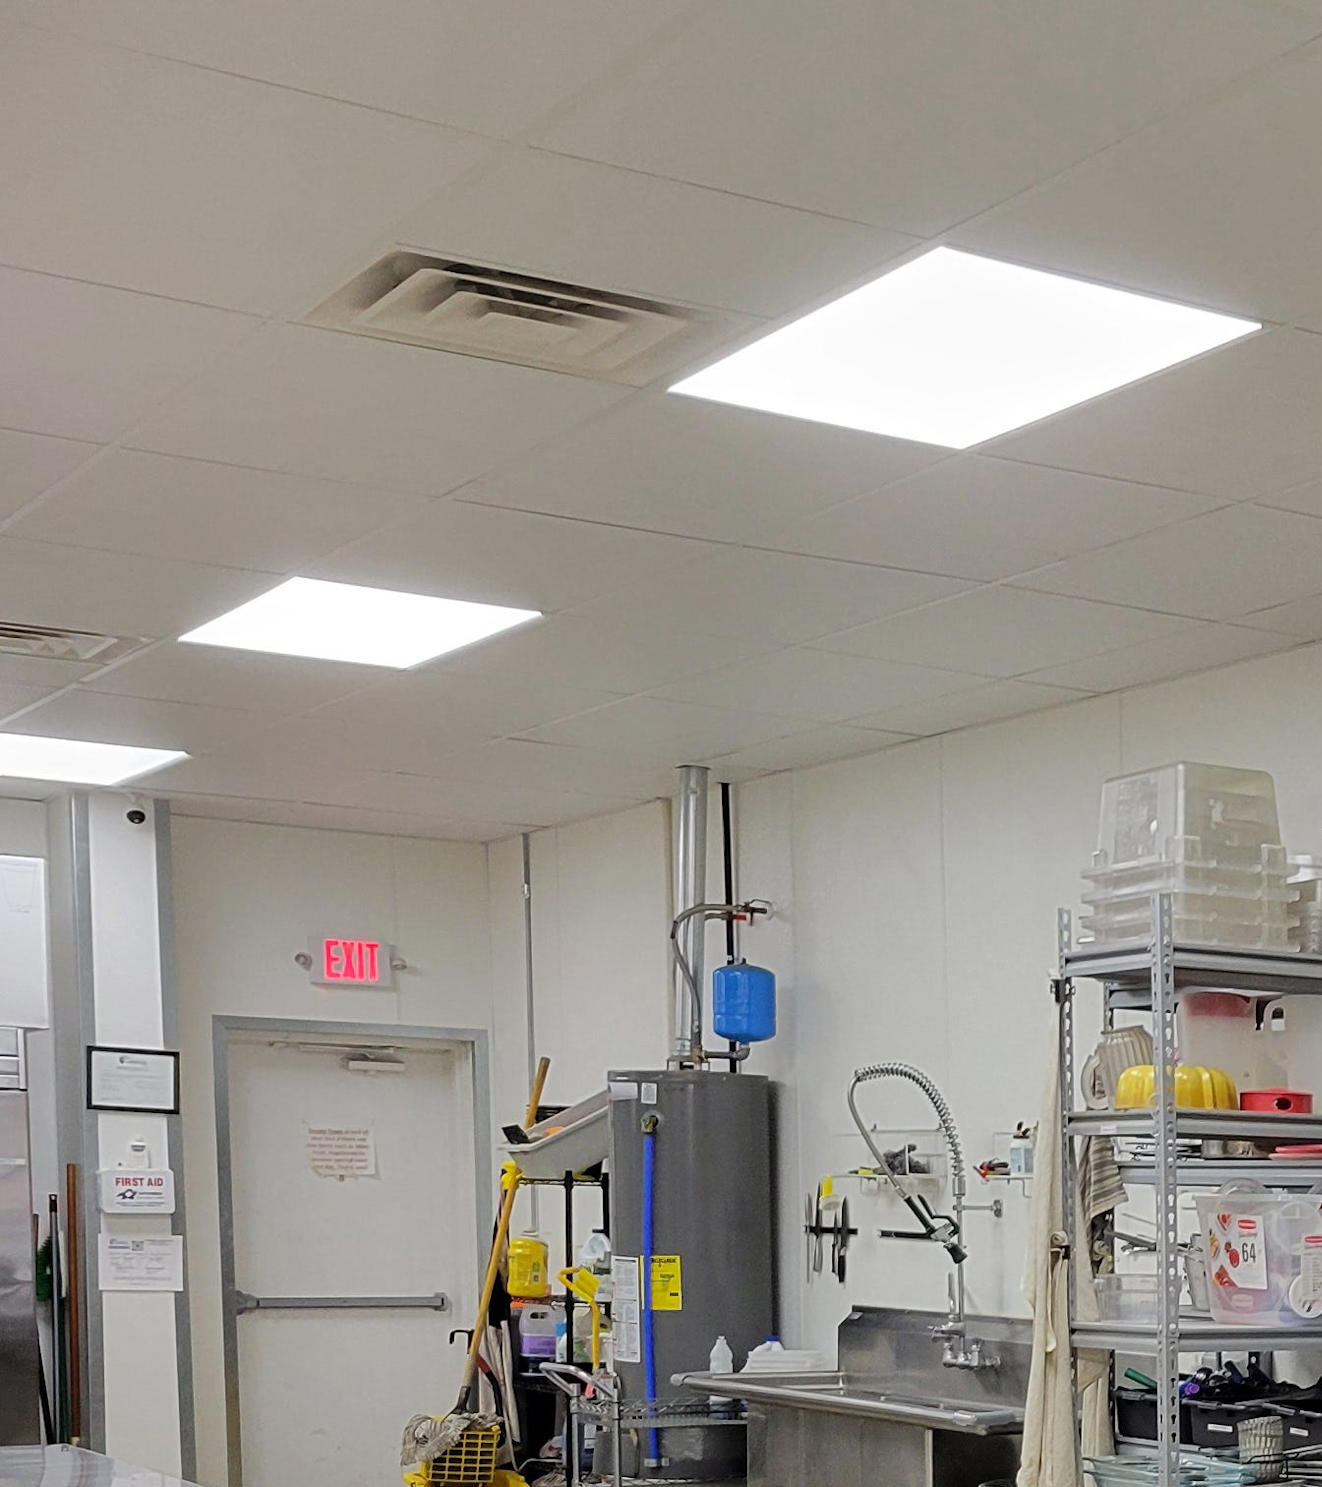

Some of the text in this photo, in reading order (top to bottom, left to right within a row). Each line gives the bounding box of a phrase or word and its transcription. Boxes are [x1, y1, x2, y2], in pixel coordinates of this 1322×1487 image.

[324, 939, 379, 981] EXIT
[115, 1177, 164, 1187] FIRST AID
[1241, 1242, 1257, 1264] 64
